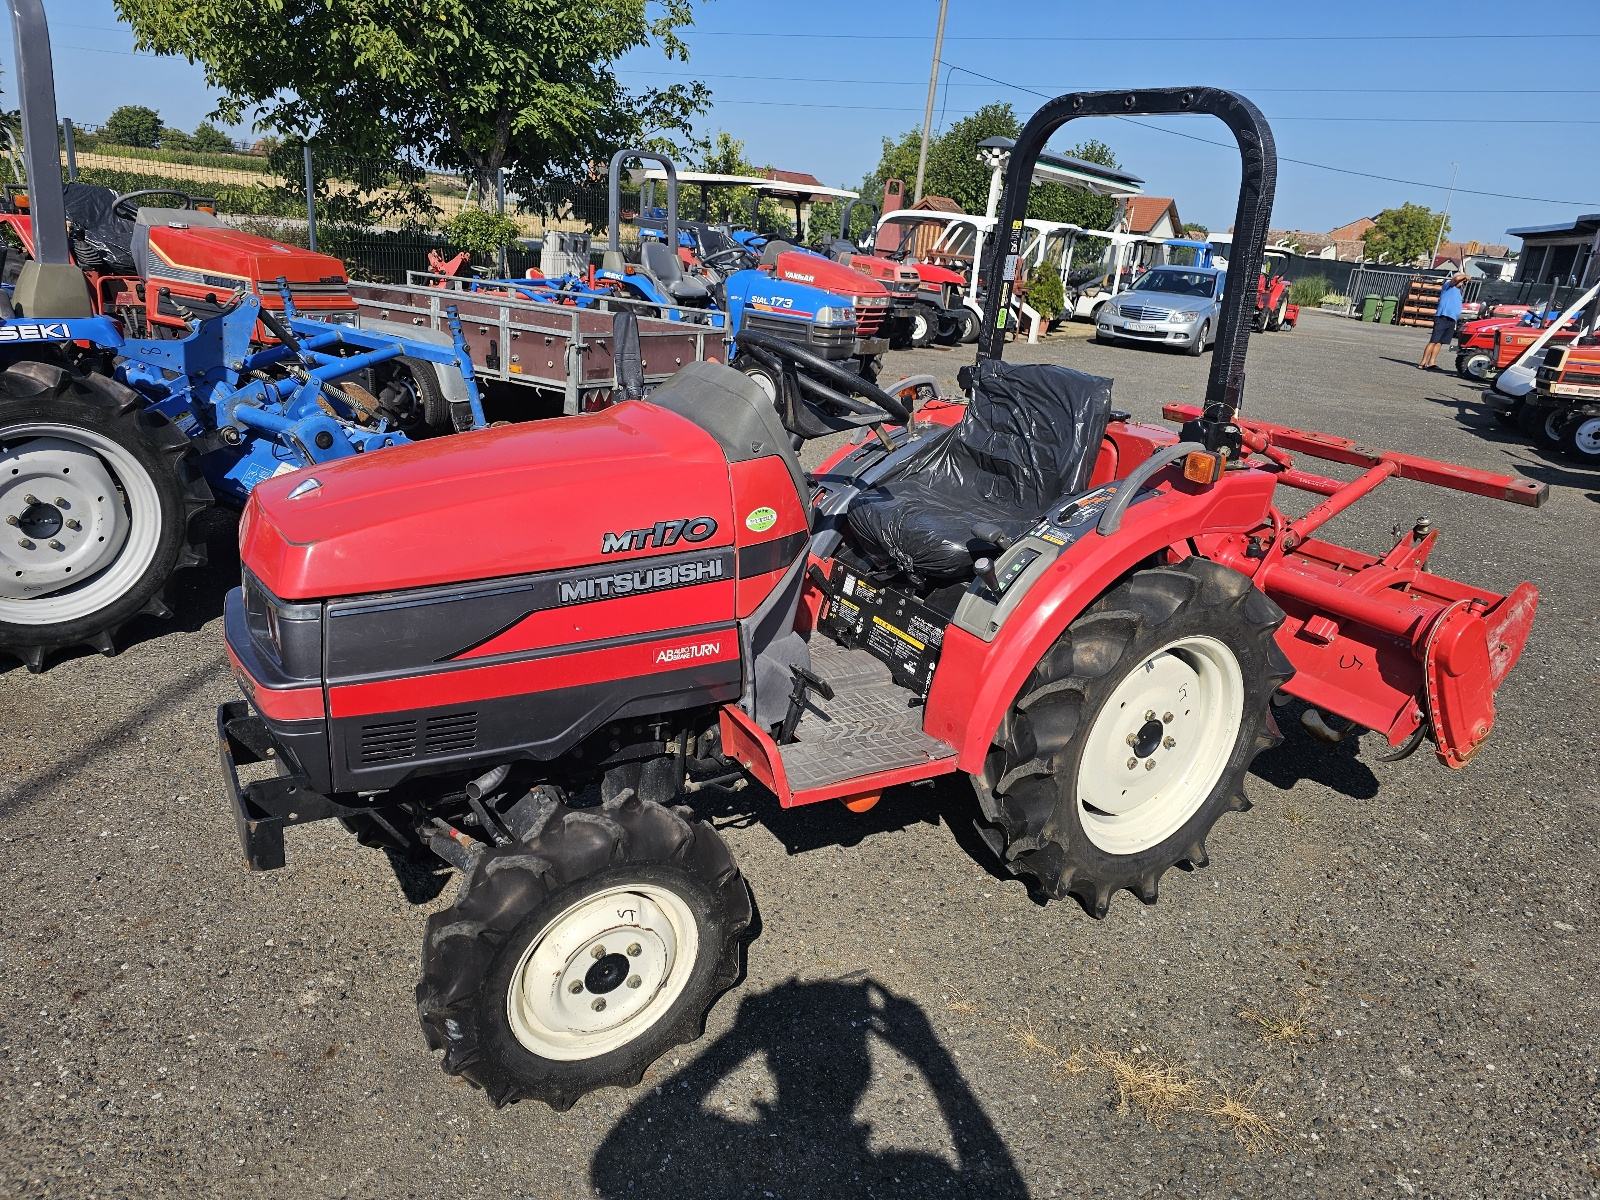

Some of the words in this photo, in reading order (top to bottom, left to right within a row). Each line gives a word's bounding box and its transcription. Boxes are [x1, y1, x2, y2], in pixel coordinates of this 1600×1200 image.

[785, 270, 815, 283] YANMAR
[751, 295, 770, 305] SIAL
[770, 296, 794, 309] 173
[601, 516, 719, 555] MT170
[559, 558, 723, 603] MITSUBISHI
[689, 642, 720, 658] TURN
